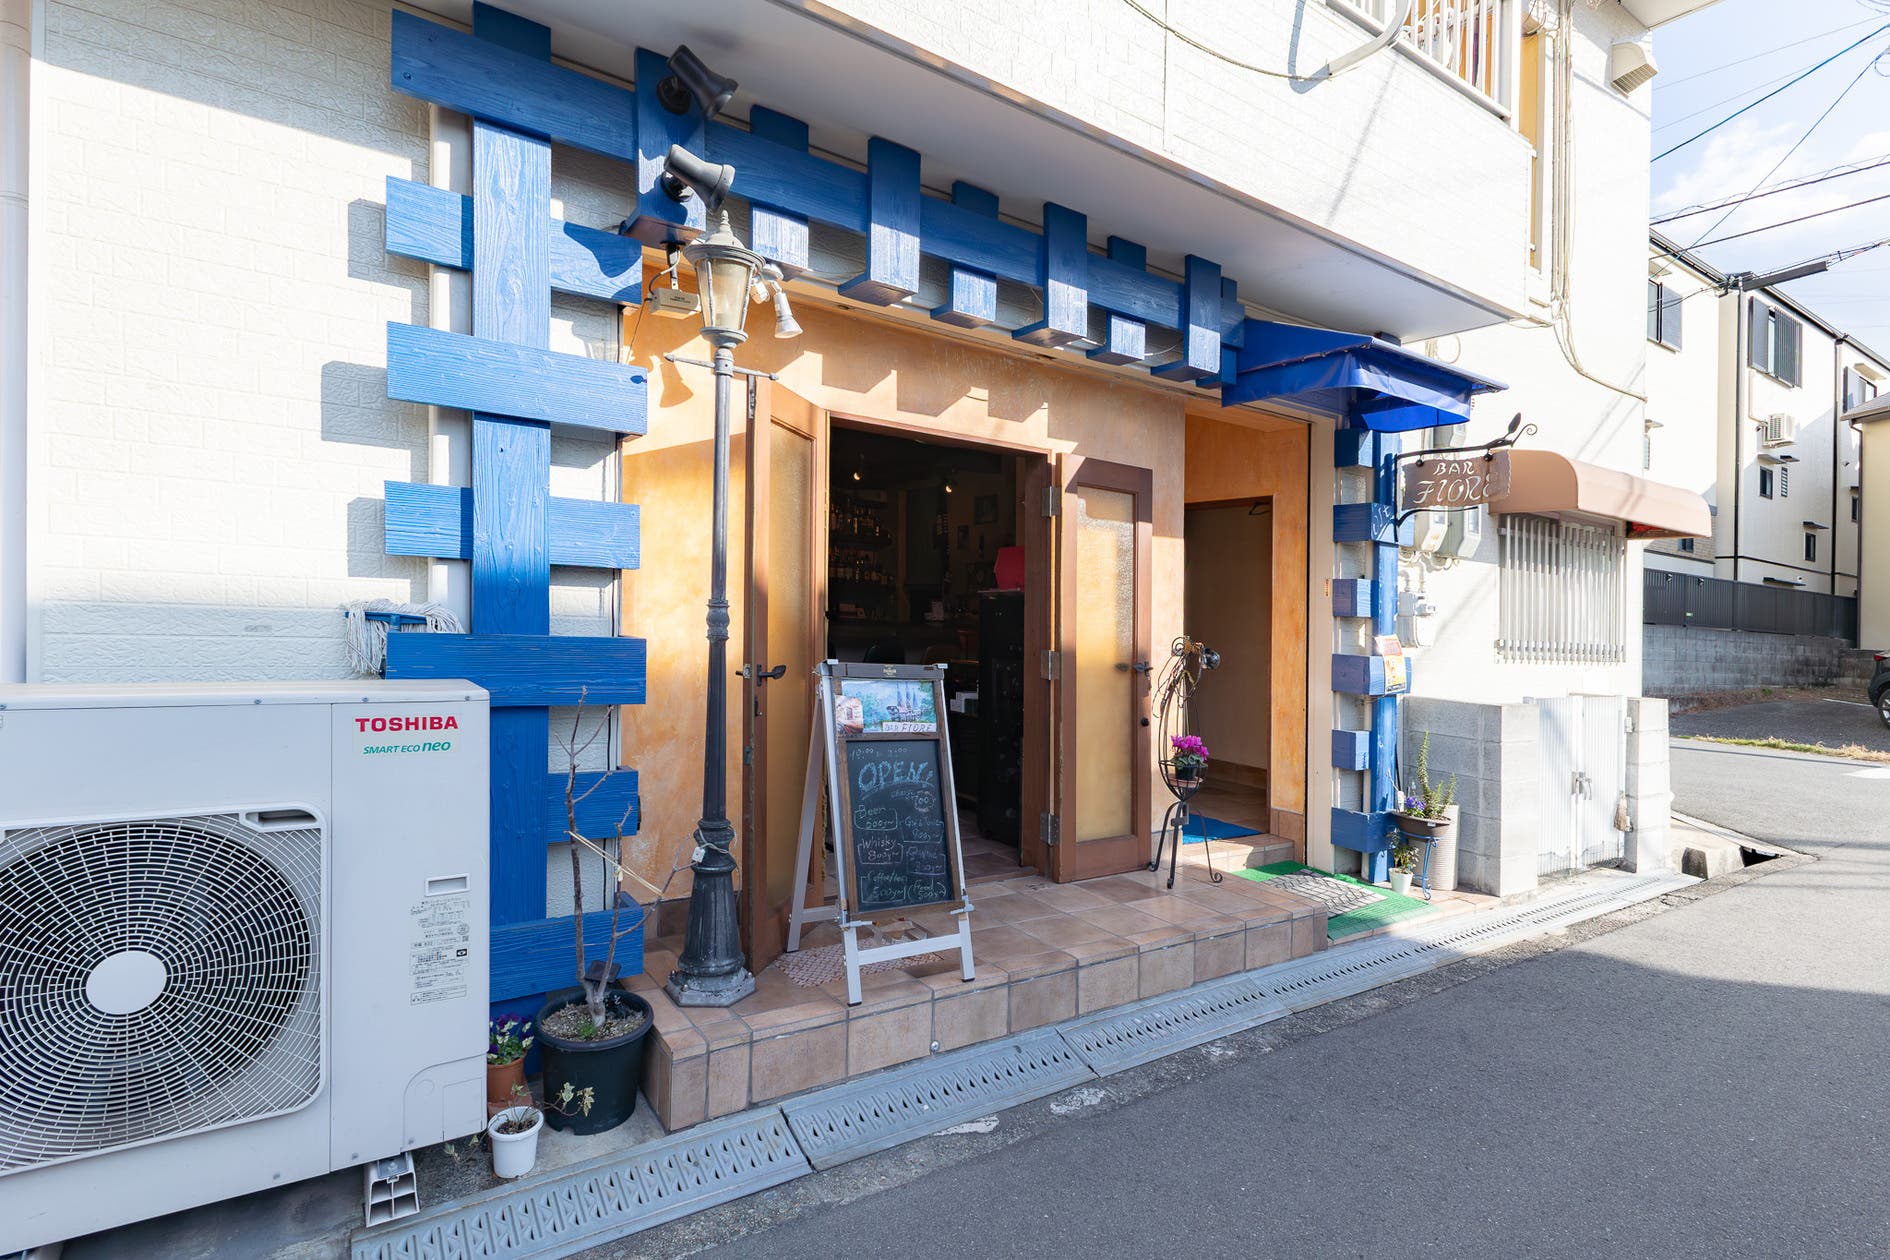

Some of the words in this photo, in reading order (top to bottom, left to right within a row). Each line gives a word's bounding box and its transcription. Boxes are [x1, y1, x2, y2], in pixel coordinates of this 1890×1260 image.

[1433, 461, 1474, 476] BAR
[355, 716, 458, 732] TOSHIBA
[363, 746, 400, 754] SMART
[401, 745, 420, 753] ECO
[422, 741, 451, 752] neo
